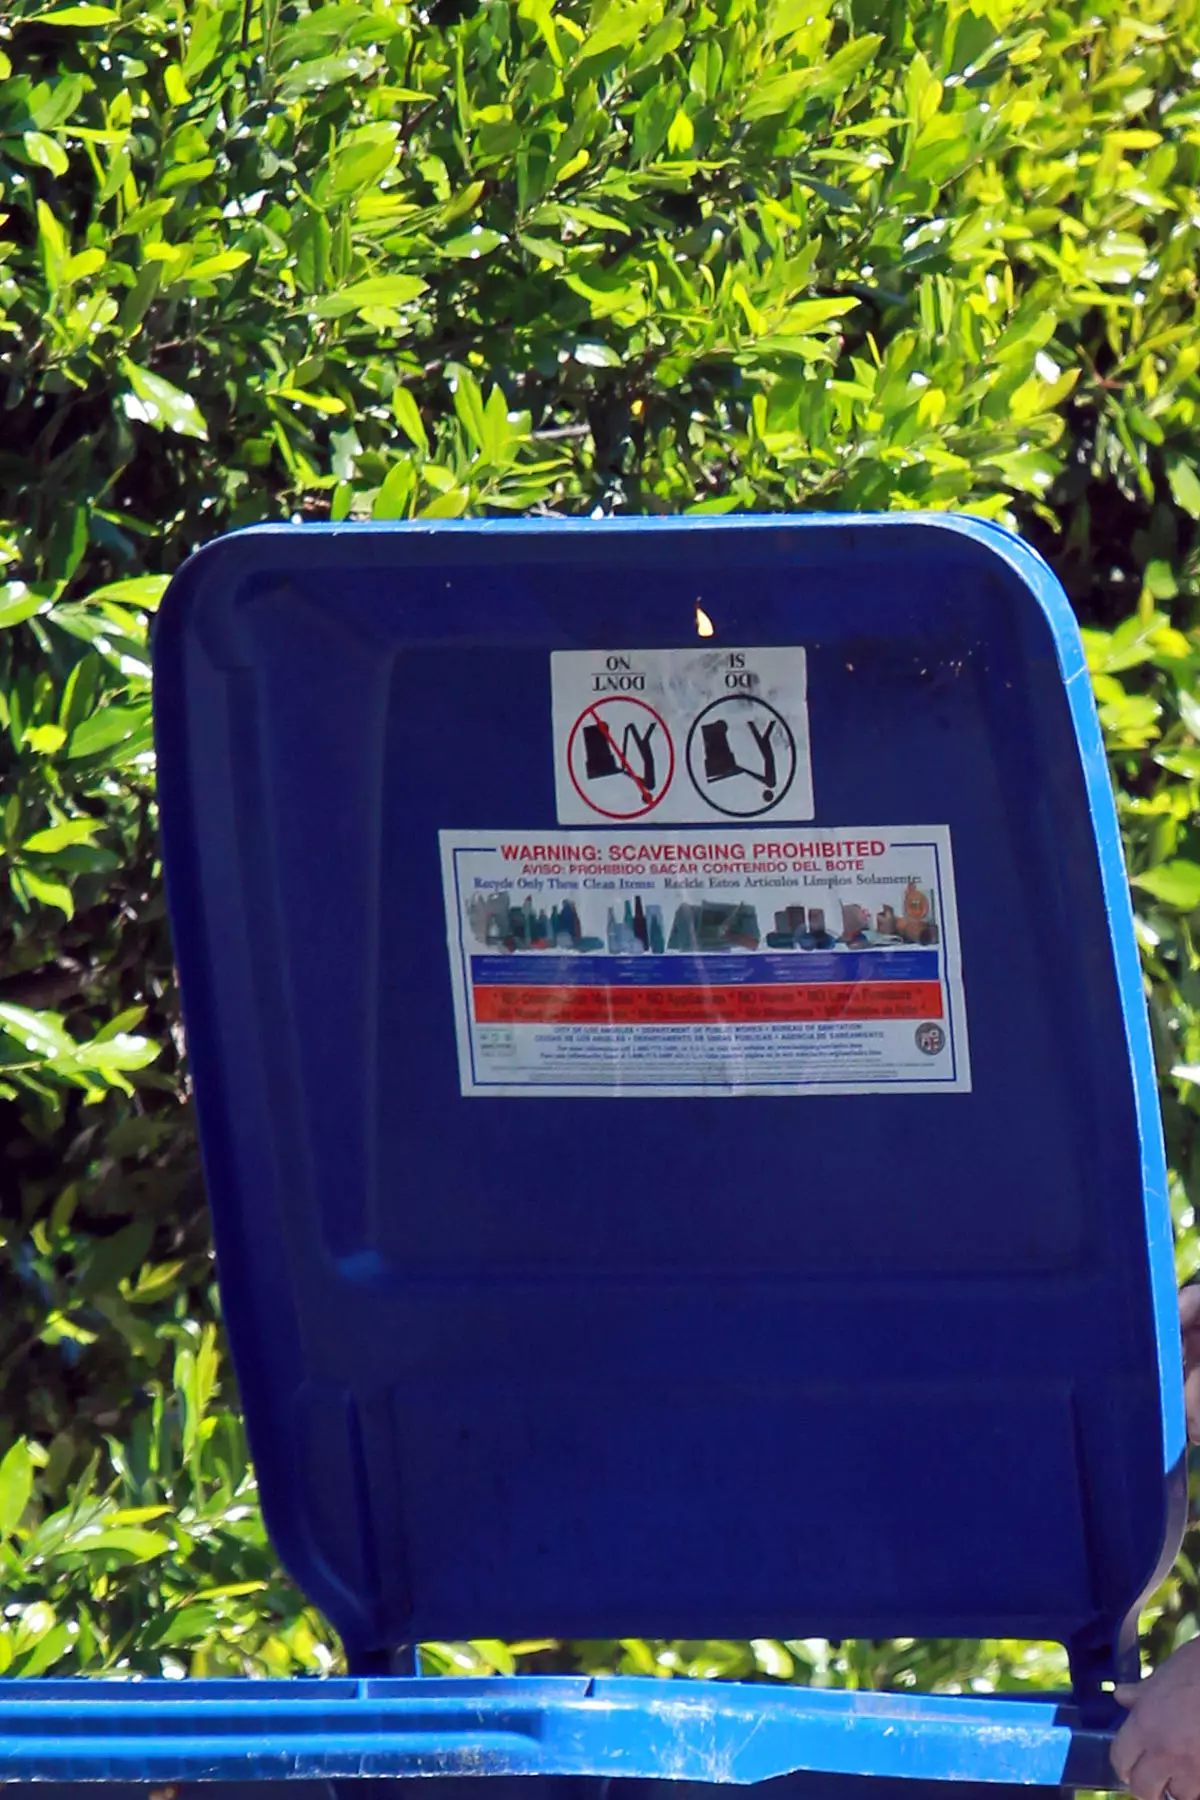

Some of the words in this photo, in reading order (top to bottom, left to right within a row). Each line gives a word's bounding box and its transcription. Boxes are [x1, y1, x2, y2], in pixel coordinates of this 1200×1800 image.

[606, 655, 631, 671] NO
[725, 673, 752, 689] DO
[500, 844, 602, 862] WARNING:
[608, 842, 746, 861] SCAVENGING
[752, 840, 887, 859] PROHIBITED
[521, 863, 567, 875] AVISO:
[569, 862, 646, 875] PROHIBIDO
[650, 862, 698, 874] SACAR
[703, 861, 788, 874] CONTENIDO
[792, 860, 821, 872] DEL
[825, 859, 866, 871] BOTE
[473, 877, 514, 891] Recycle
[516, 877, 544, 892] Only
[583, 877, 616, 889] Clean
[708, 876, 741, 888] Estos
